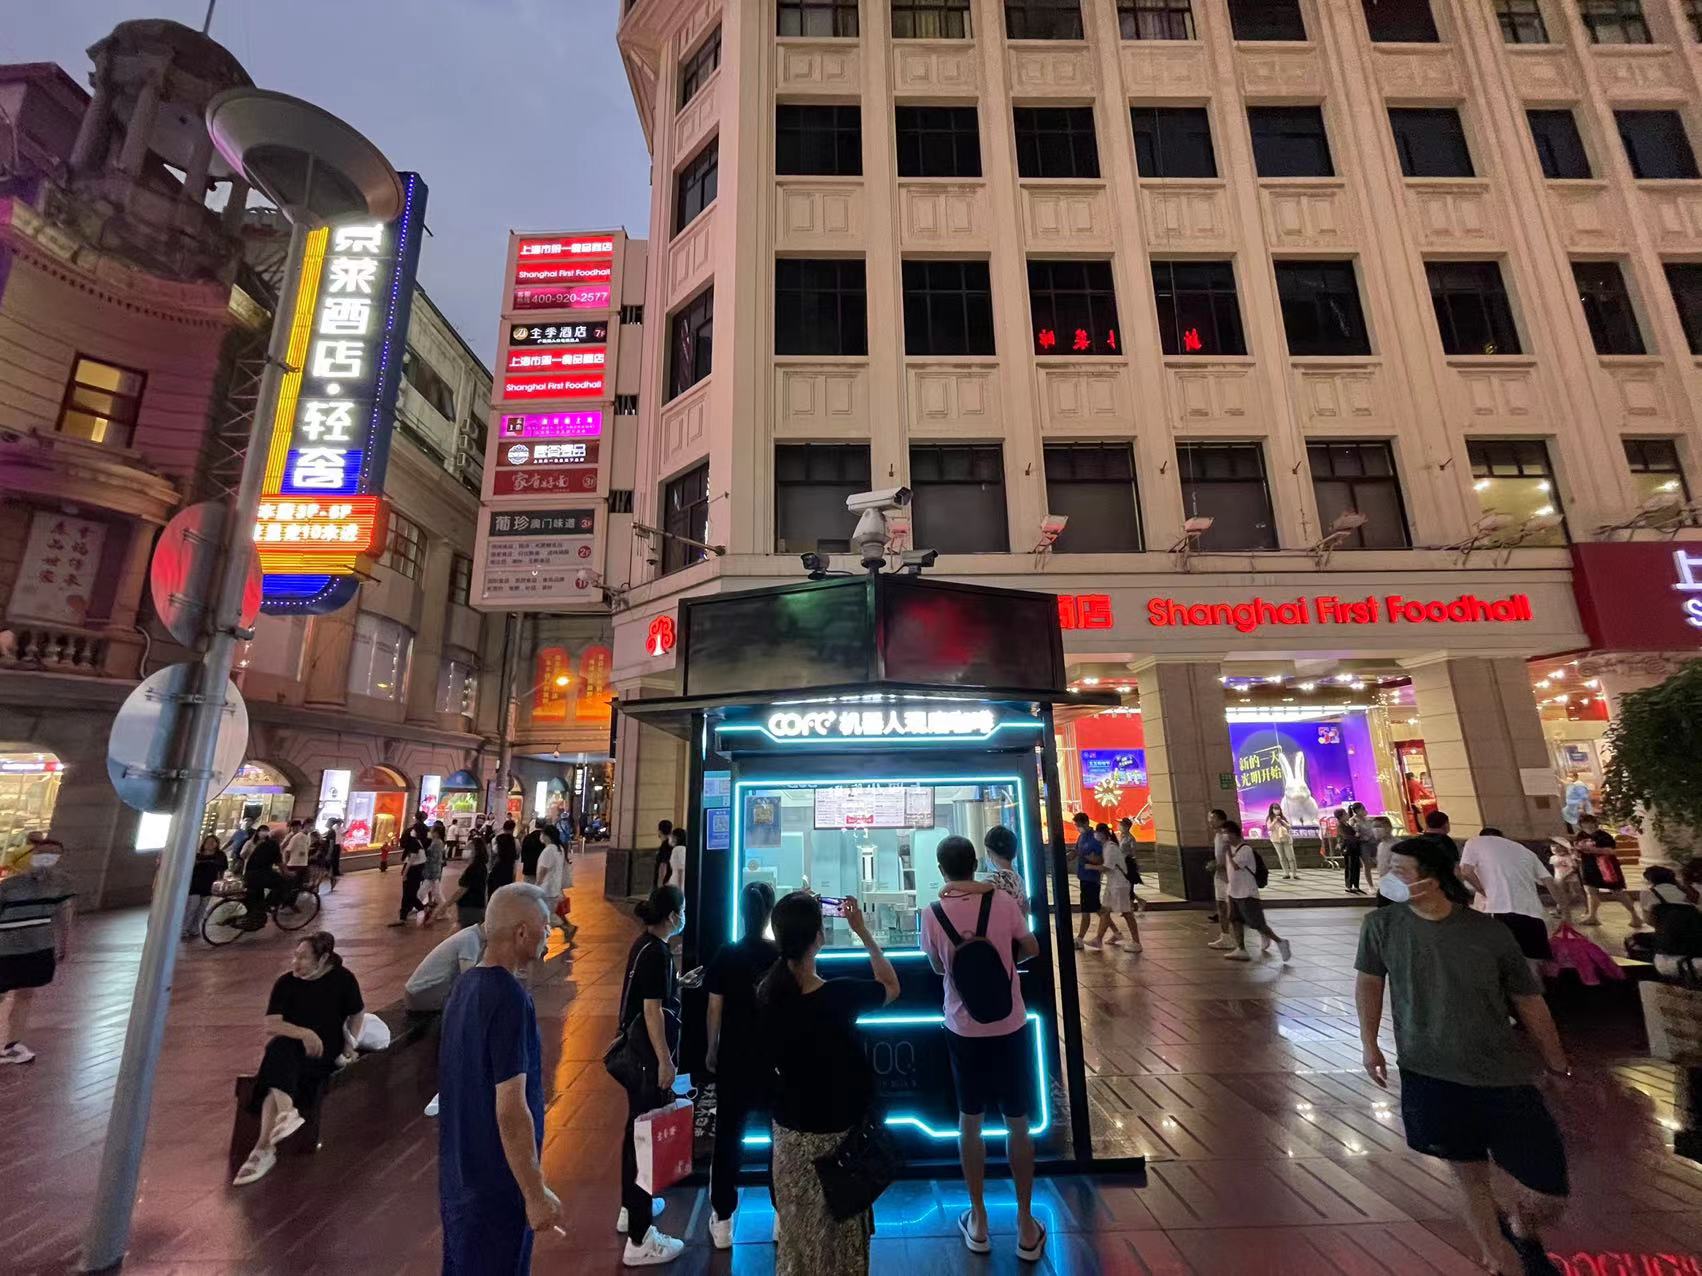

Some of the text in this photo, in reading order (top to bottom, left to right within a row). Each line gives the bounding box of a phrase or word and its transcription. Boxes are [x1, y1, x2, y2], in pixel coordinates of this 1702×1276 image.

[519, 268, 611, 279] Shanghai First Foodhall
[531, 291, 608, 304] 400-920-2577
[529, 325, 587, 339] 全季酒店
[506, 379, 602, 393] Shanghai First Foodhall
[1147, 593, 1534, 633] Shanghai First Foodhall
